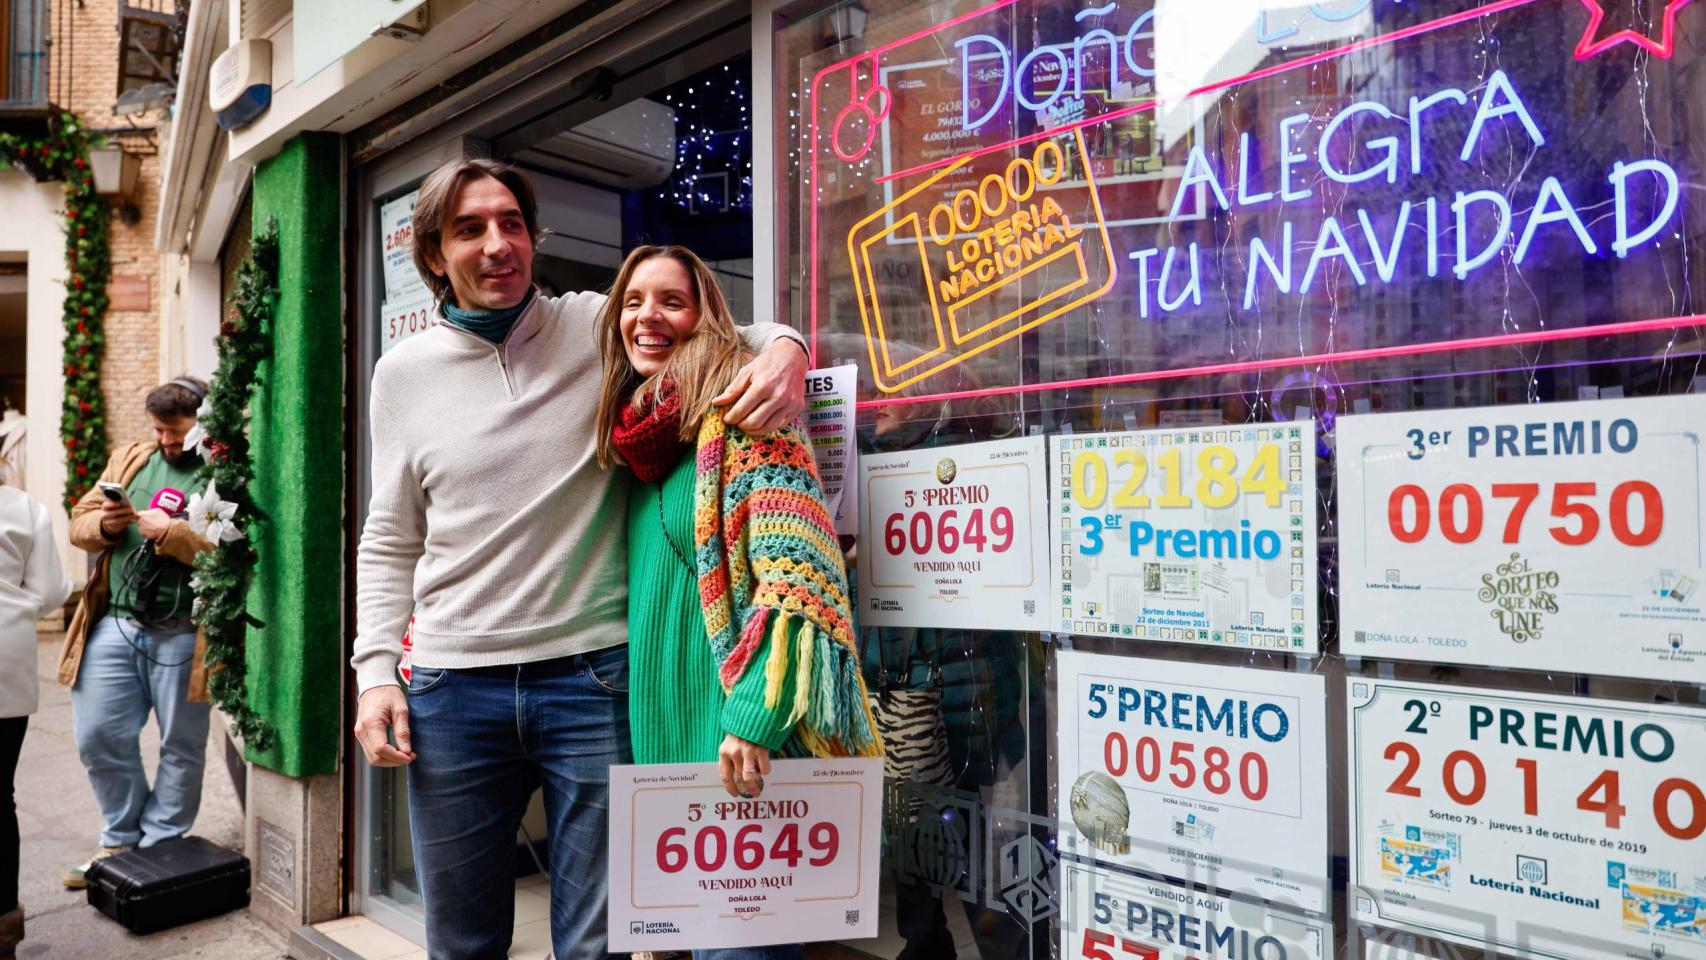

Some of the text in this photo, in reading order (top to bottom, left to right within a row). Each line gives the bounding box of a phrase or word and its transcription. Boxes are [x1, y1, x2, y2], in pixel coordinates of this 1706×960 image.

[920, 98, 981, 115] EL GORO
[946, 196, 1063, 273] LOTERIA
[1129, 159, 1679, 318] TU NAVIDAD
[940, 214, 1083, 303] NACIONAL
[1468, 418, 1639, 458] PREMIO
[923, 484, 990, 507] PREMIO
[1071, 443, 1289, 511] 02184
[885, 506, 1014, 556] 60649
[1388, 480, 1664, 547] 00750
[1129, 519, 1282, 561] Premio
[913, 558, 982, 574] VENDIDO AQUÍ
[1137, 616, 1146, 624] 22
[1157, 617, 1191, 626] diciembre
[1193, 620, 1210, 628] 2011
[1142, 607, 1165, 615] Sorteo
[1176, 609, 1205, 618] Navidad
[1367, 632, 1392, 642] DOÑA
[1394, 635, 1419, 644] LOLA
[1427, 637, 1467, 648] TOLEDO
[1469, 704, 1674, 763] PREMIO
[1104, 731, 1269, 801] 00580
[714, 800, 809, 821] PREMIO
[1383, 740, 1706, 841] 20140
[656, 821, 840, 874] 60649
[1429, 809, 1462, 824] Sorteo
[1464, 815, 1478, 826] 79
[1488, 818, 1523, 835] jueves
[1526, 825, 1533, 835] 3
[1535, 827, 1549, 838] de
[1552, 831, 1597, 848] octubre
[1599, 837, 1614, 850] de
[1616, 839, 1648, 855] 2019
[698, 873, 793, 891] VENDIDO AQUÍ
[728, 894, 767, 903] DOÑA LOLA
[1147, 885, 1224, 913] VENDIDO AQUÍ
[1529, 884, 1600, 910] Nacional
[734, 905, 761, 913] TOLEDO
[646, 926, 681, 935] NACIONAL
[1127, 900, 1288, 960] PREMIO
